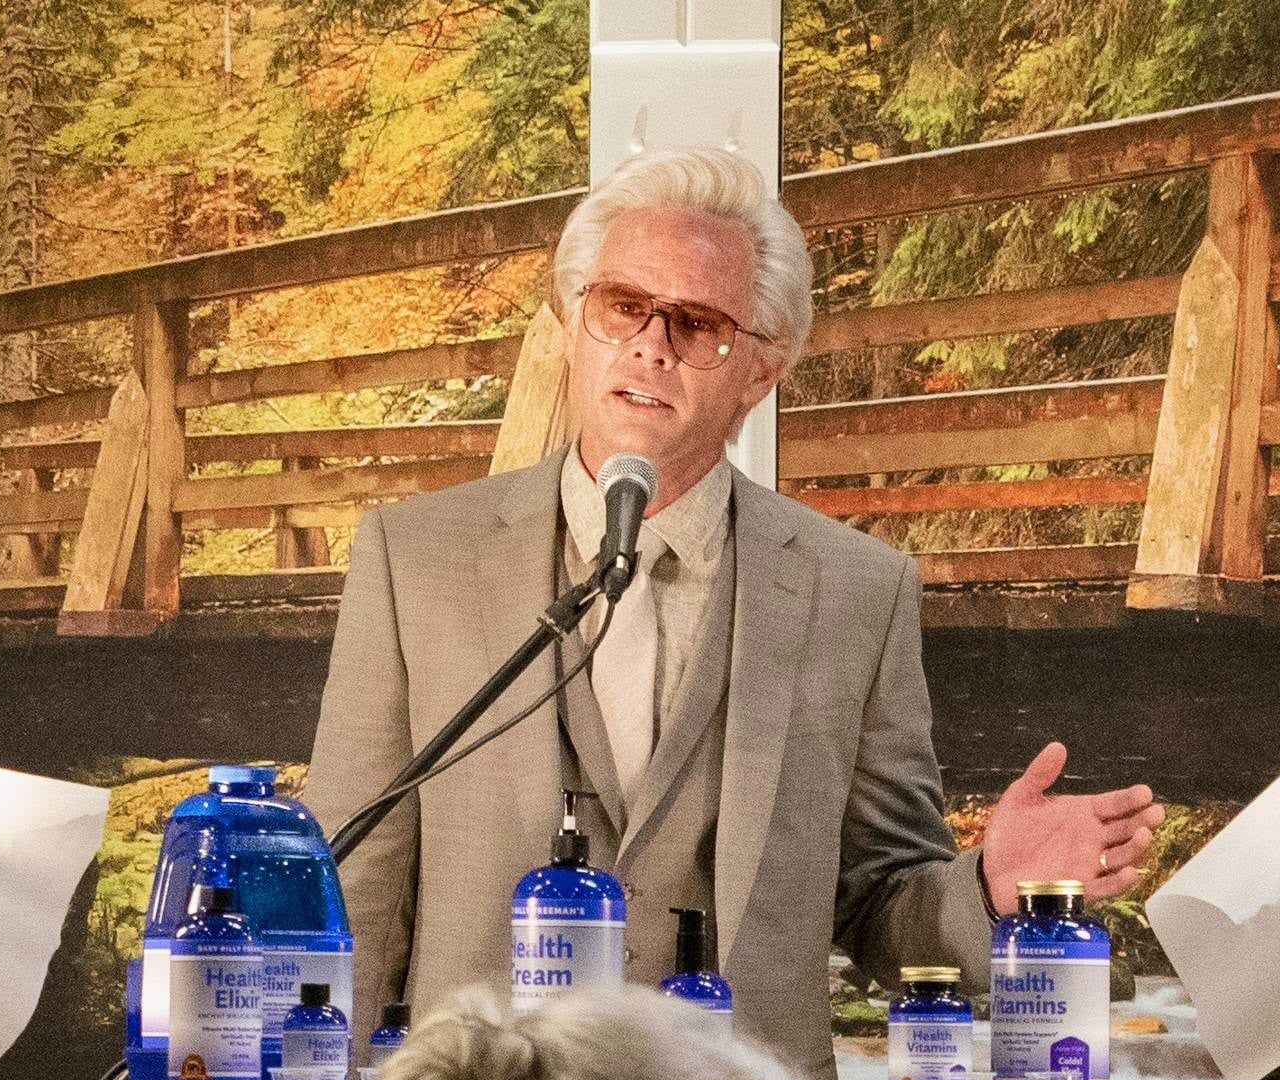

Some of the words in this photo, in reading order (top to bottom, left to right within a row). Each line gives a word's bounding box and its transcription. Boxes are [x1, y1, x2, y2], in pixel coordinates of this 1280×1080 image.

[264, 961, 300, 976] ealth
[512, 968, 573, 986] ream
[994, 972, 1055, 993] Health
[215, 989, 260, 1009] Elixir
[912, 1029, 953, 1042] Health
[907, 1042, 958, 1054] Vitamins
[312, 1051, 341, 1062] Elixir
